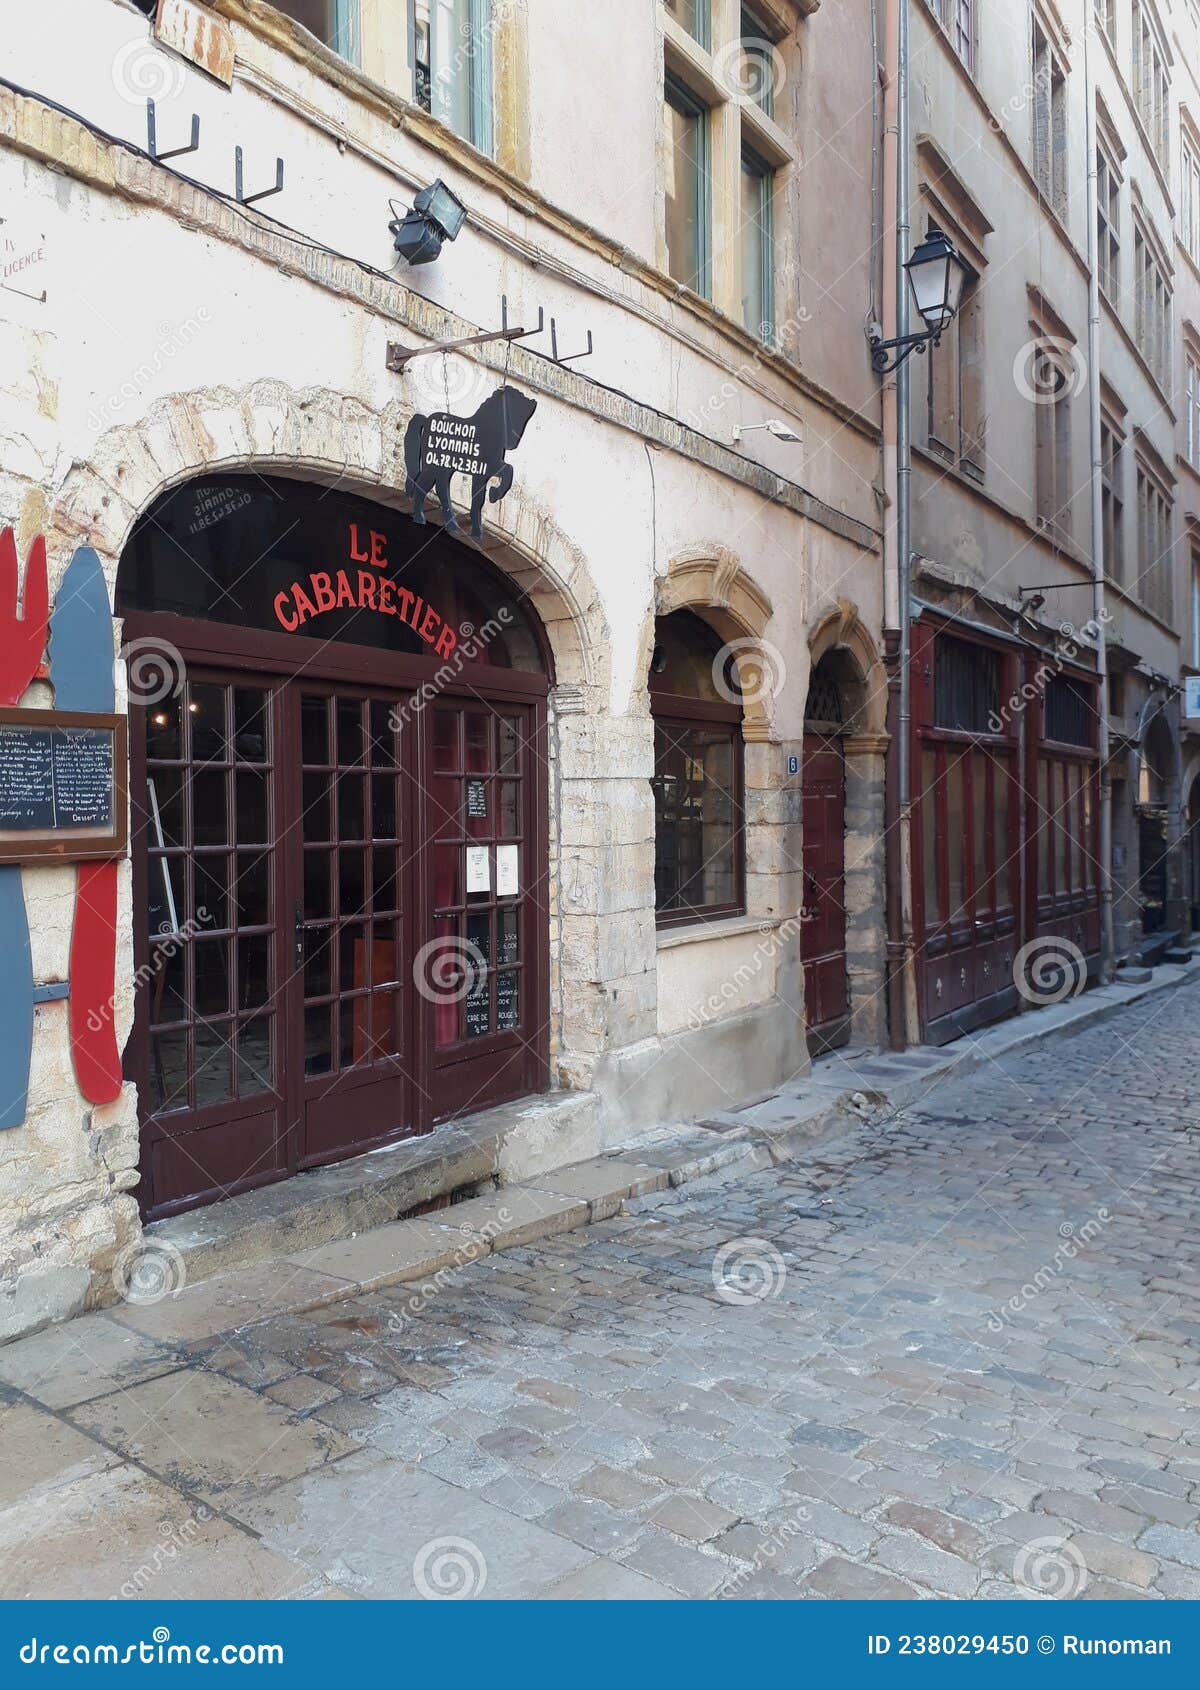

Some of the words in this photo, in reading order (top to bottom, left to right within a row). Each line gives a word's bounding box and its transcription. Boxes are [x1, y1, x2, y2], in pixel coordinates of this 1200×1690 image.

[430, 419, 476, 438] BOUCHON
[348, 523, 388, 568] LE
[273, 569, 457, 660] CABARETIER
[790, 758, 796, 771] 6
